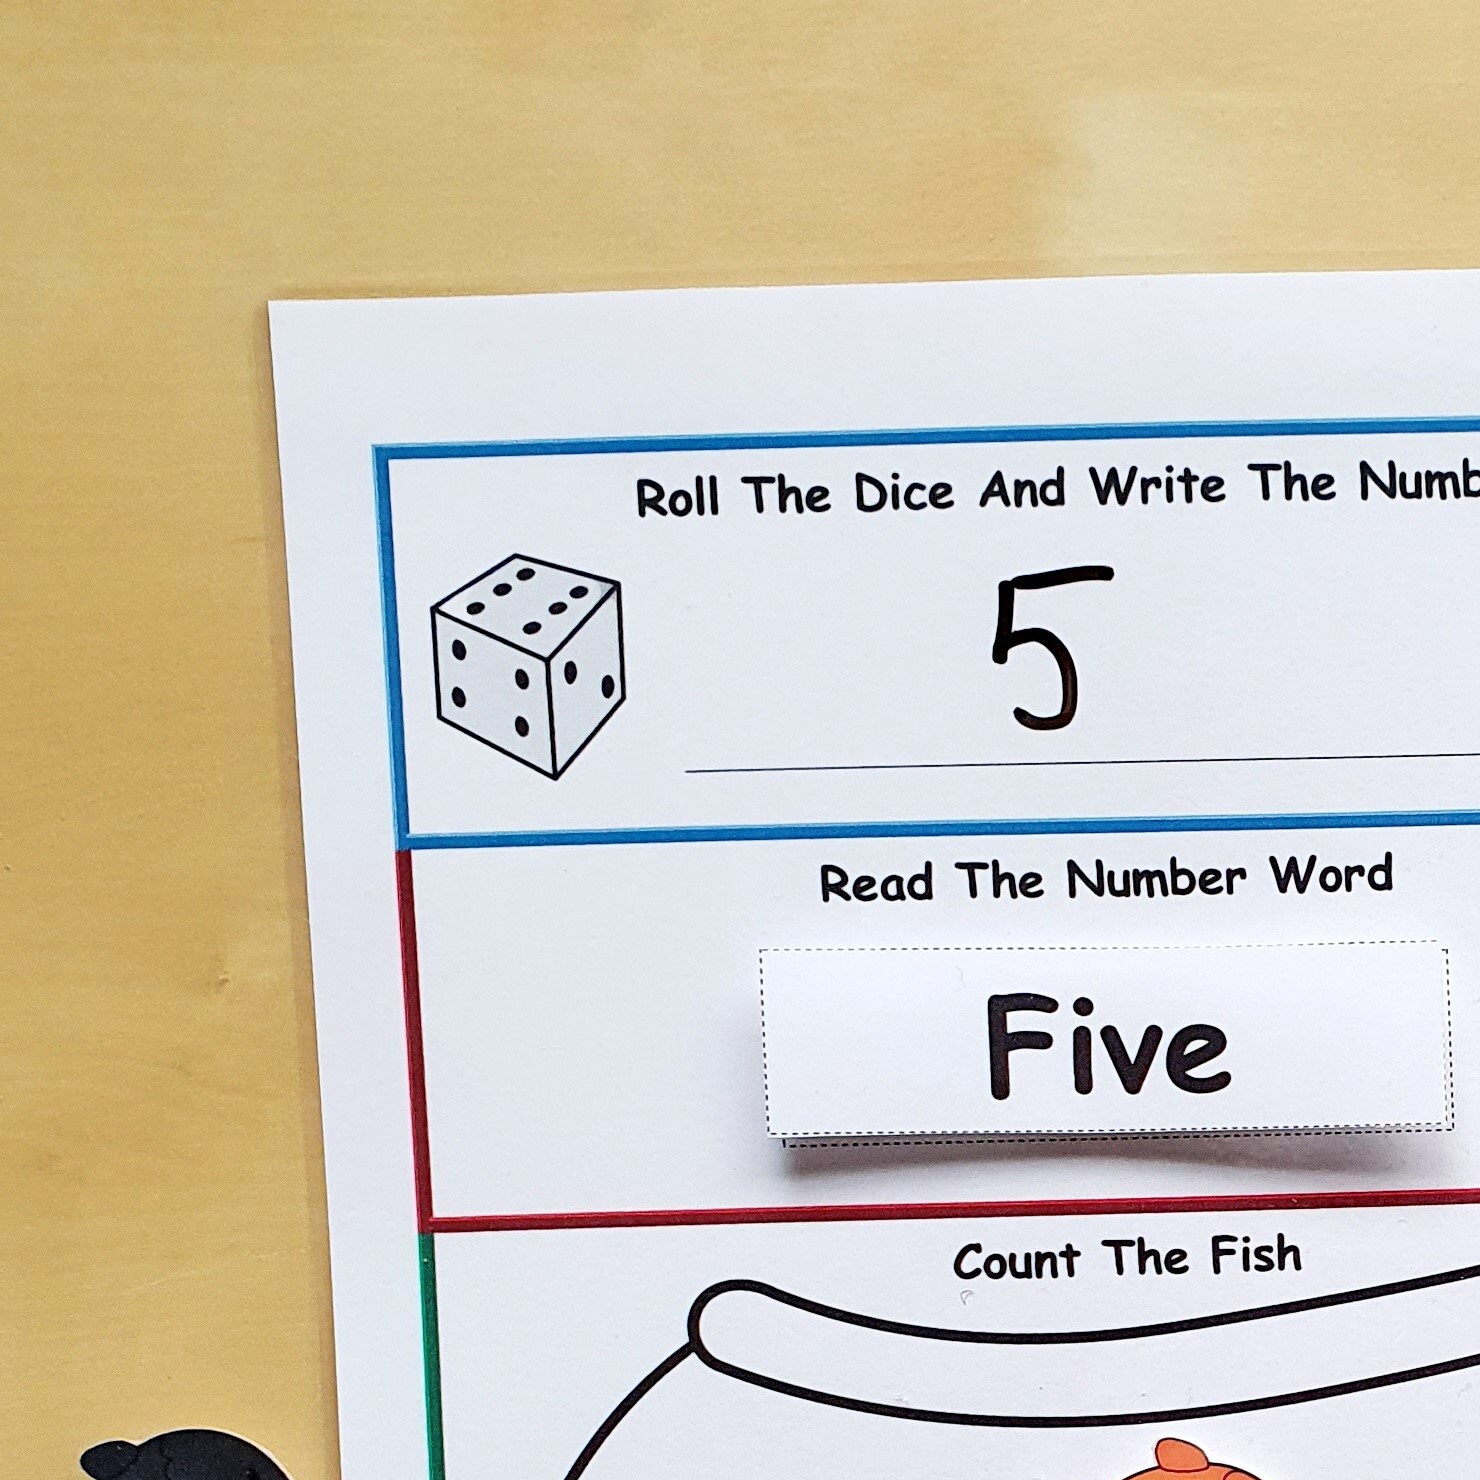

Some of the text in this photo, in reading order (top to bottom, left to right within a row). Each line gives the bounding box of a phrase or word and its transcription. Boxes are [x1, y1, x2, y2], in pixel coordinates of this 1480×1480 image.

[635, 473, 720, 519] Roll
[739, 472, 833, 516] The
[854, 471, 956, 514] Dice
[978, 464, 1067, 509] And
[1087, 463, 1227, 508] Write
[1246, 459, 1338, 503] The
[990, 564, 1116, 732] 5
[819, 850, 1394, 904] Read The Number Word
[986, 991, 1233, 1102] Five
[952, 1231, 1303, 1281] Count The Fish
